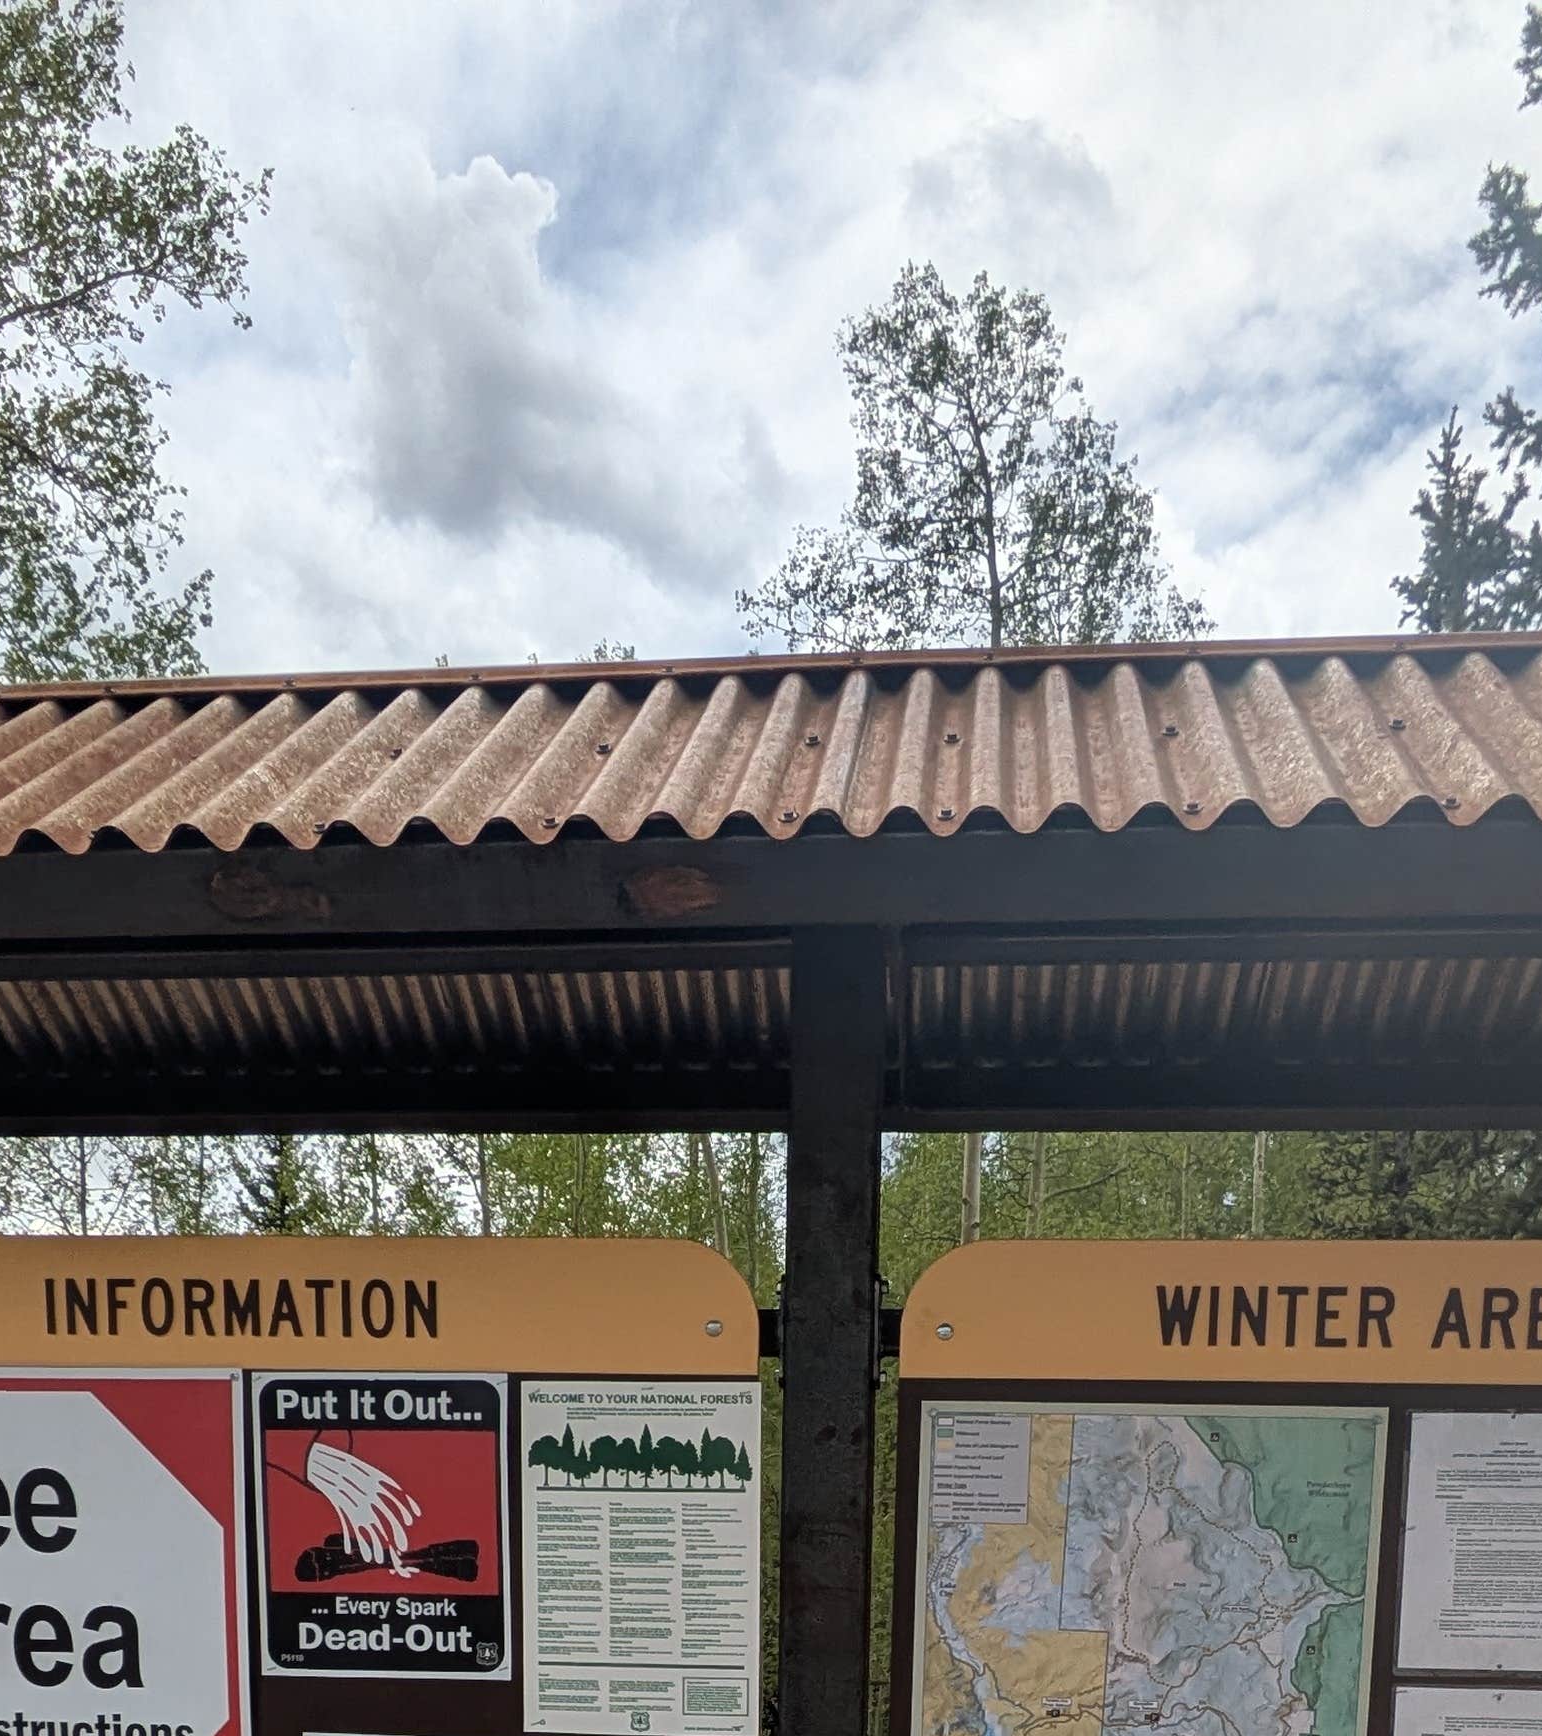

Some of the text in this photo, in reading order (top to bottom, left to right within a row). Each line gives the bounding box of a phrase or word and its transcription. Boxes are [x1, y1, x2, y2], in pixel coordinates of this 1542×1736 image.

[44, 1278, 439, 1340] INFORMATION
[1156, 1286, 1396, 1348] WINTER
[276, 1389, 482, 1421] Put It Out...
[528, 1393, 752, 1404] WELCOME TO YOUR NATIONAL FORESTS
[335, 1596, 390, 1619] Every
[396, 1598, 457, 1620] Spark
[299, 1622, 473, 1653] Dead-Out
